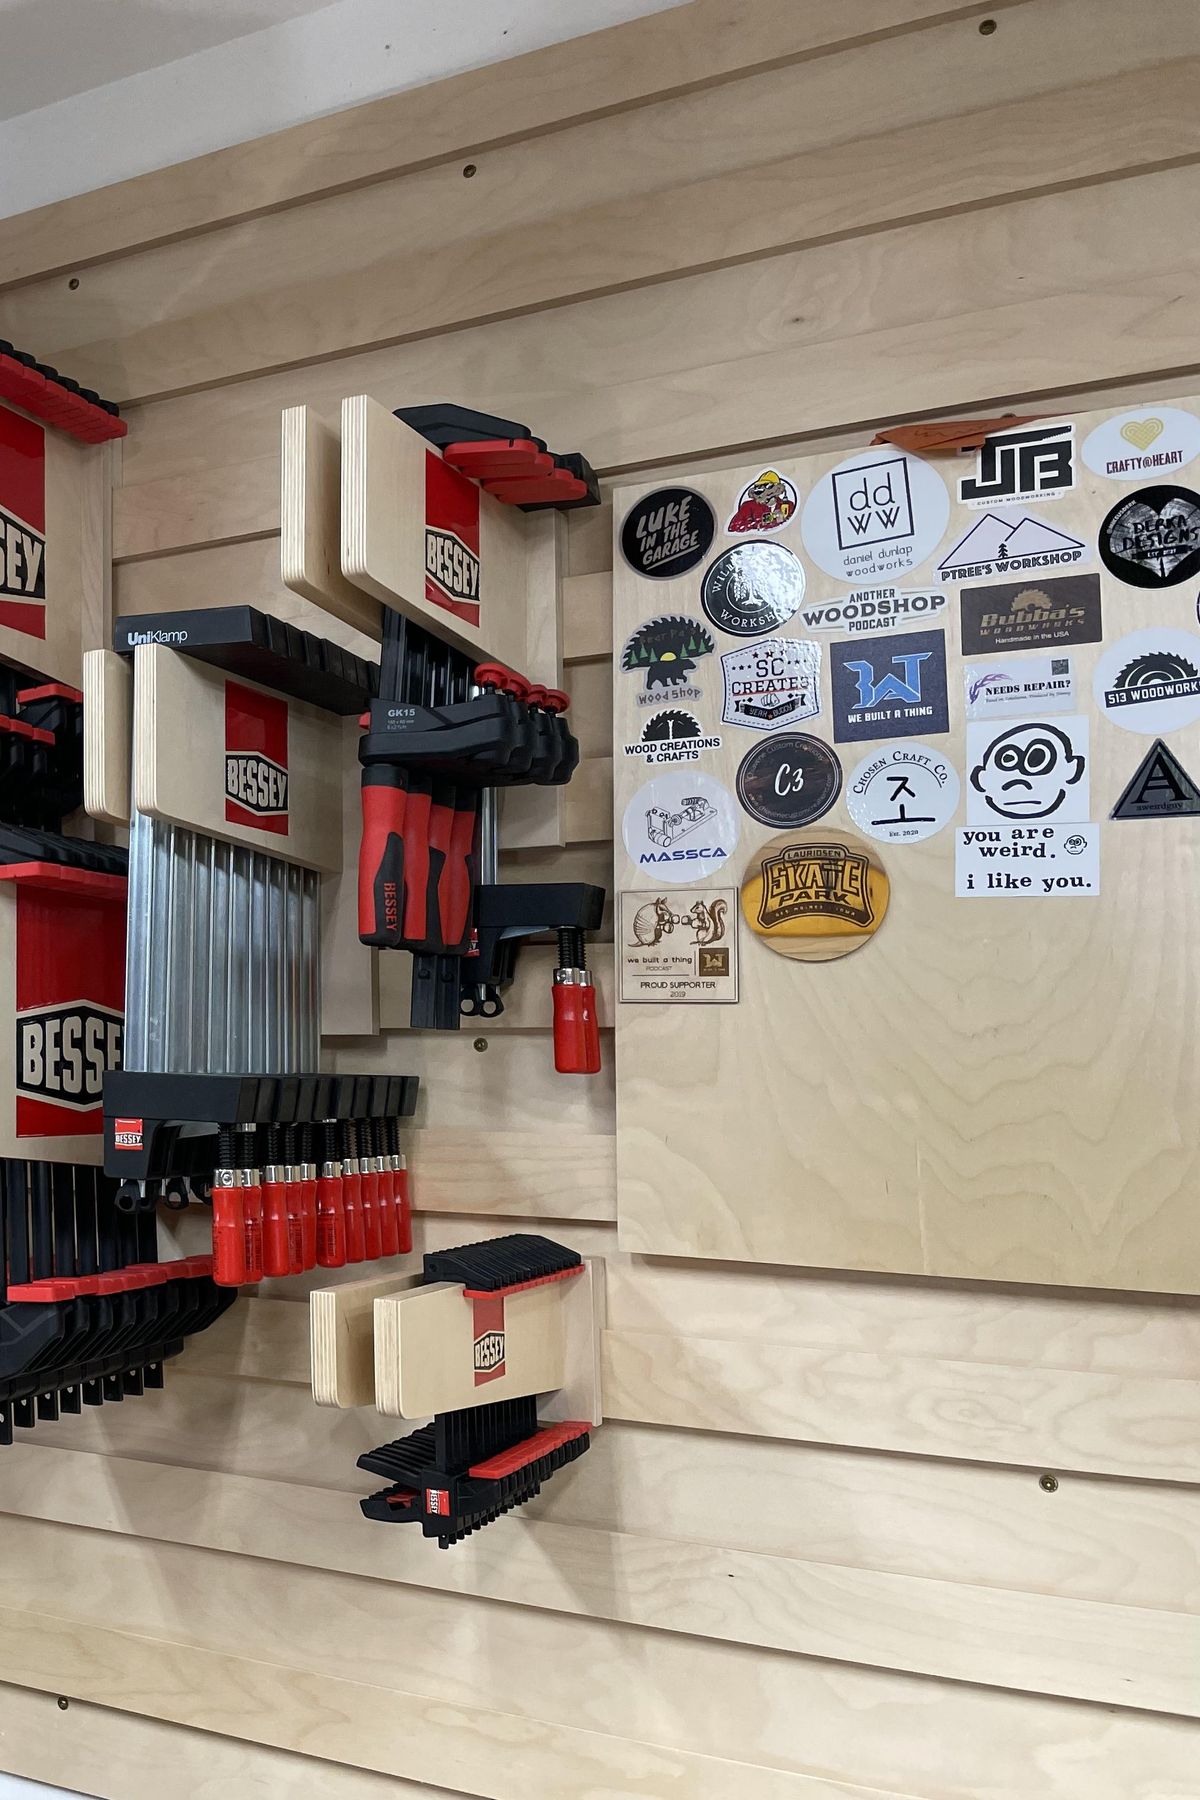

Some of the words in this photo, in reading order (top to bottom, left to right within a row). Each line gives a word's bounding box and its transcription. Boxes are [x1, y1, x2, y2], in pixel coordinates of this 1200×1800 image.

[1106, 450, 1183, 474] CRAFTY@HEART
[636, 496, 693, 539] LUKE
[640, 535, 656, 553] IN
[663, 519, 690, 540] THE
[642, 530, 699, 565] GARAGE
[843, 551, 873, 566] daniel
[878, 545, 913, 561] dunlap
[427, 533, 479, 597] BESSEY
[846, 558, 913, 577] woodworks
[941, 563, 993, 581] PTREE'S
[995, 550, 1082, 571] WORKSHOP
[849, 588, 895, 603] ANOTHER
[802, 595, 946, 626] WOODSHOP
[980, 604, 1086, 628] Bubba's
[849, 616, 897, 631] PODCAST
[127, 629, 188, 646] UniKlamp
[995, 635, 1032, 644] Handmade
[1054, 630, 1070, 638] USA
[756, 658, 784, 677] SC
[985, 685, 1020, 696] NEEDS
[1023, 680, 1071, 692] REPAIR?
[1108, 692, 1127, 704] 513
[1131, 680, 1200, 700] WOODWORK
[387, 709, 415, 717] GK15
[848, 714, 862, 724] WE
[864, 711, 892, 721] BUILT
[894, 710, 901, 719] A
[903, 706, 932, 717] THING
[625, 743, 657, 754] WOOD
[660, 738, 720, 752] CREATIONS
[647, 754, 654, 763] &
[656, 751, 699, 763] CRAFTS
[227, 758, 287, 809] BESSEY
[774, 763, 804, 796] C3
[963, 831, 1001, 846] you
[1011, 827, 1055, 840] are
[639, 847, 728, 864] MASSCA
[979, 842, 1056, 859] weird.
[770, 859, 860, 899] SKATE
[967, 874, 975, 889] i
[987, 872, 1032, 889] like
[1042, 876, 1092, 892] you.
[384, 882, 397, 932] BESSEY
[779, 890, 852, 907] PARK
[672, 956, 693, 964] thing
[22, 1015, 123, 1094] BESSE
[115, 1132, 142, 1145] BESSEY
[475, 1336, 504, 1368] BESSEY
